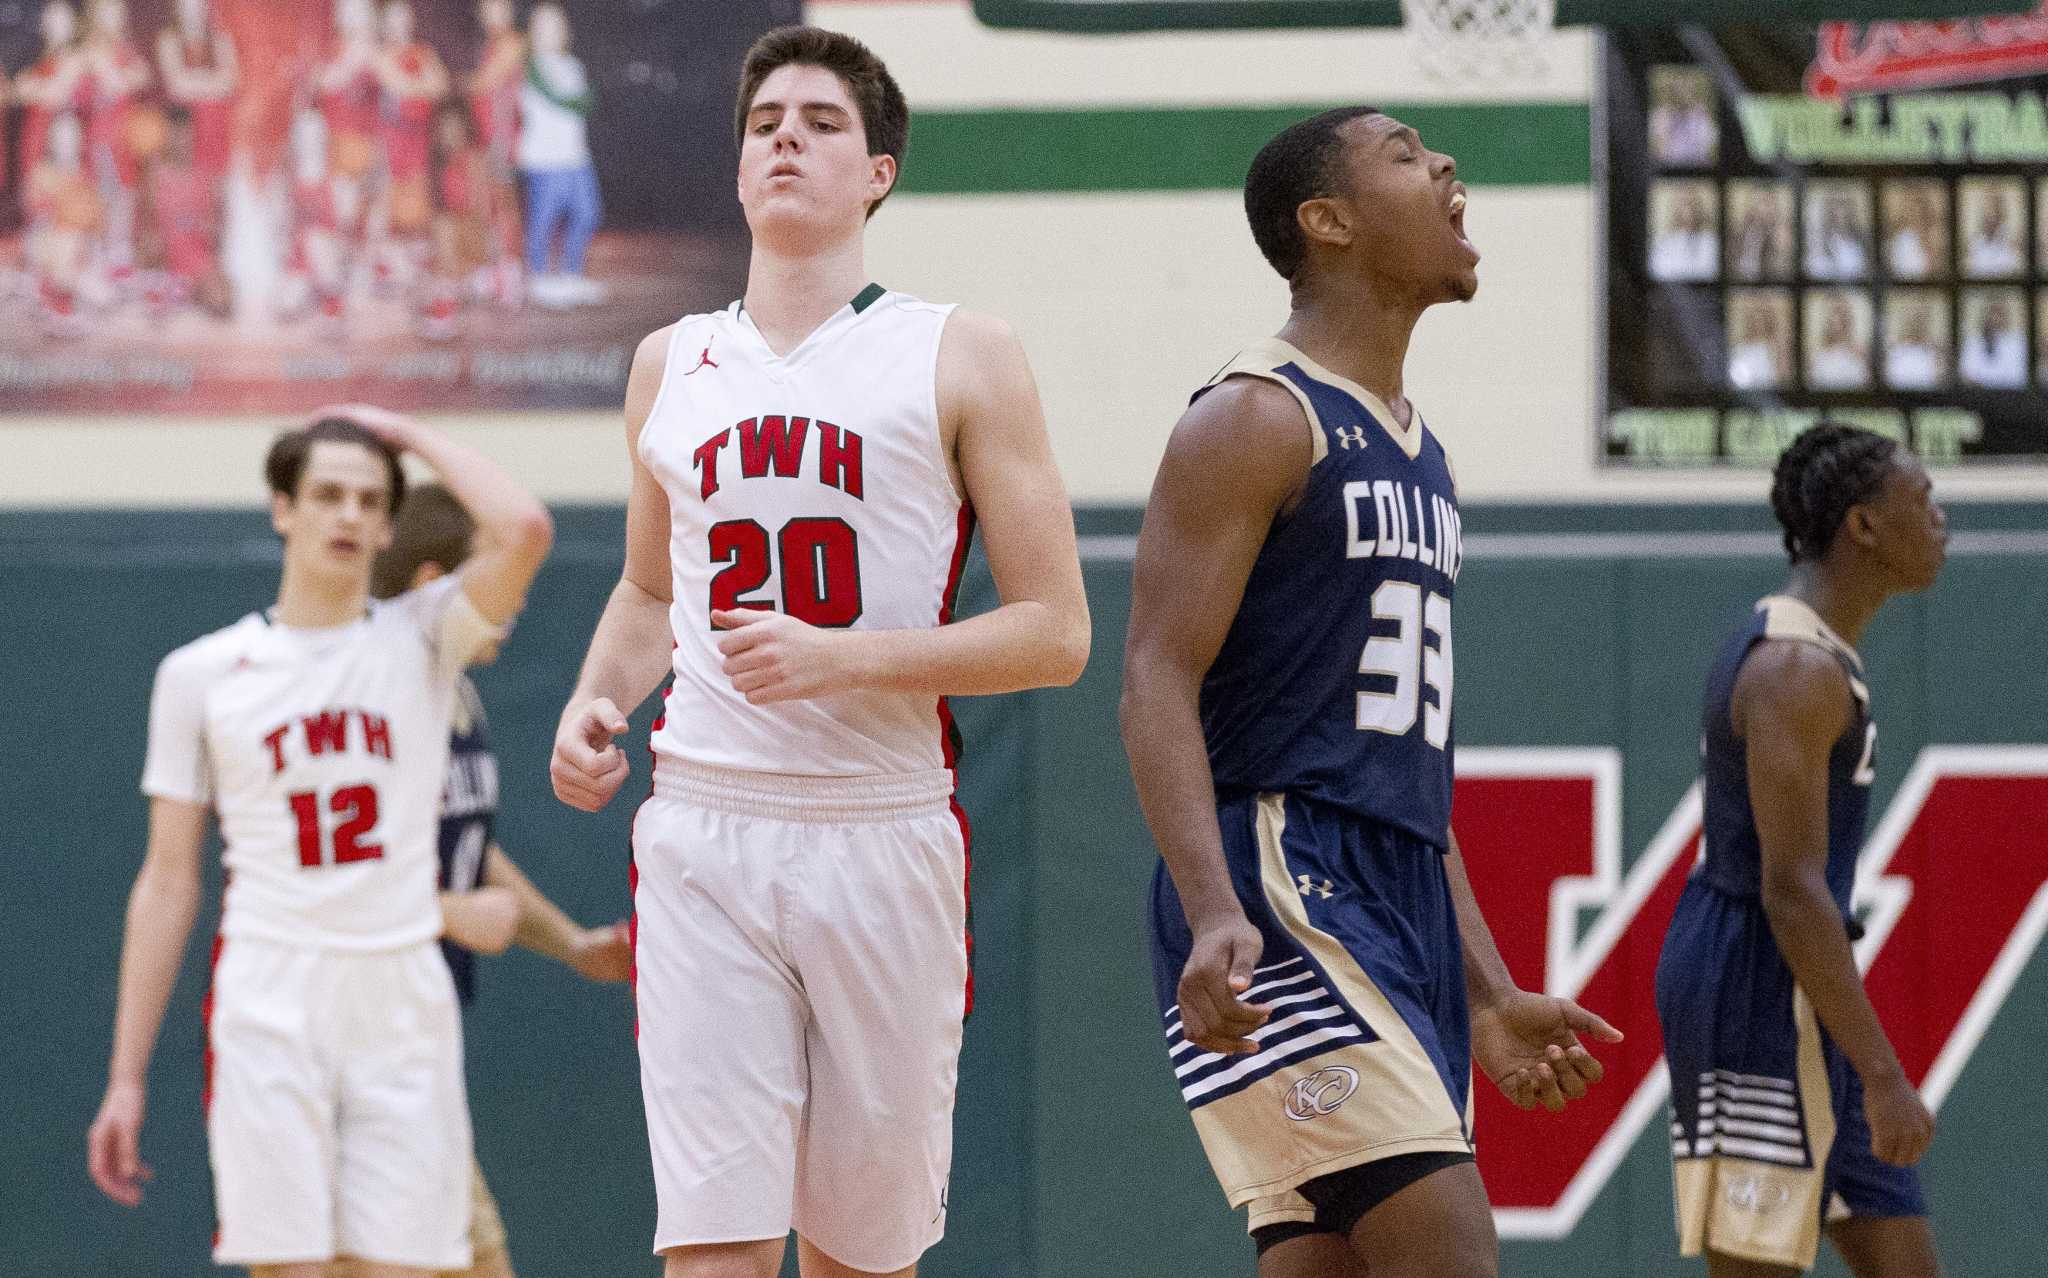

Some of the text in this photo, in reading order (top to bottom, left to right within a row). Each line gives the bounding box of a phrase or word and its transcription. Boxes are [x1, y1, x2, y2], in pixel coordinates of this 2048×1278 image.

[693, 415, 865, 502] TWH
[708, 517, 863, 631] 20
[1356, 580, 1454, 751] 33
[262, 709, 392, 776] TWH
[288, 783, 386, 867] 12
